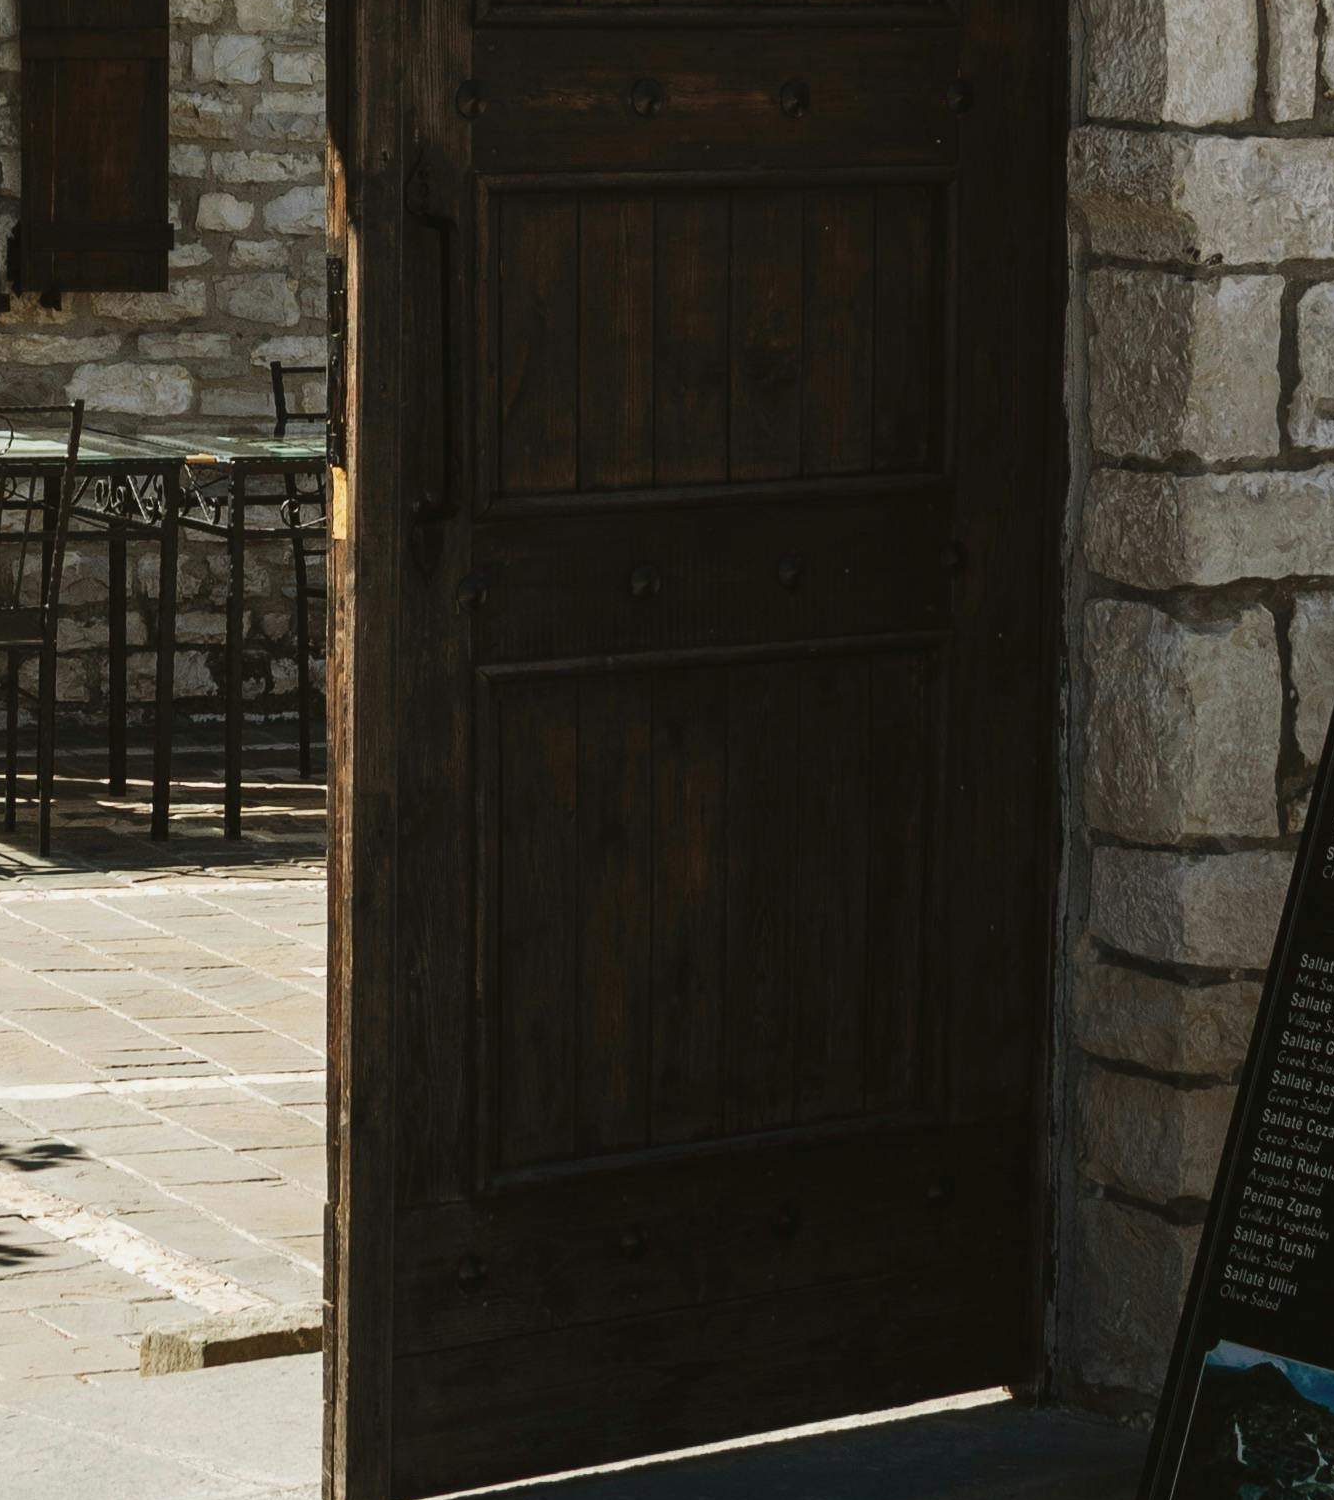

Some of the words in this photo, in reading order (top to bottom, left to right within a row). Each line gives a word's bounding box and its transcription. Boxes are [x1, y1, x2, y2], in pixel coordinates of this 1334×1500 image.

[1241, 1184, 1285, 1210] Perime
[1285, 1195, 1323, 1220] Zgare
[1278, 1234, 1317, 1260] Turshi
[1267, 1274, 1299, 1298] Ulliri
